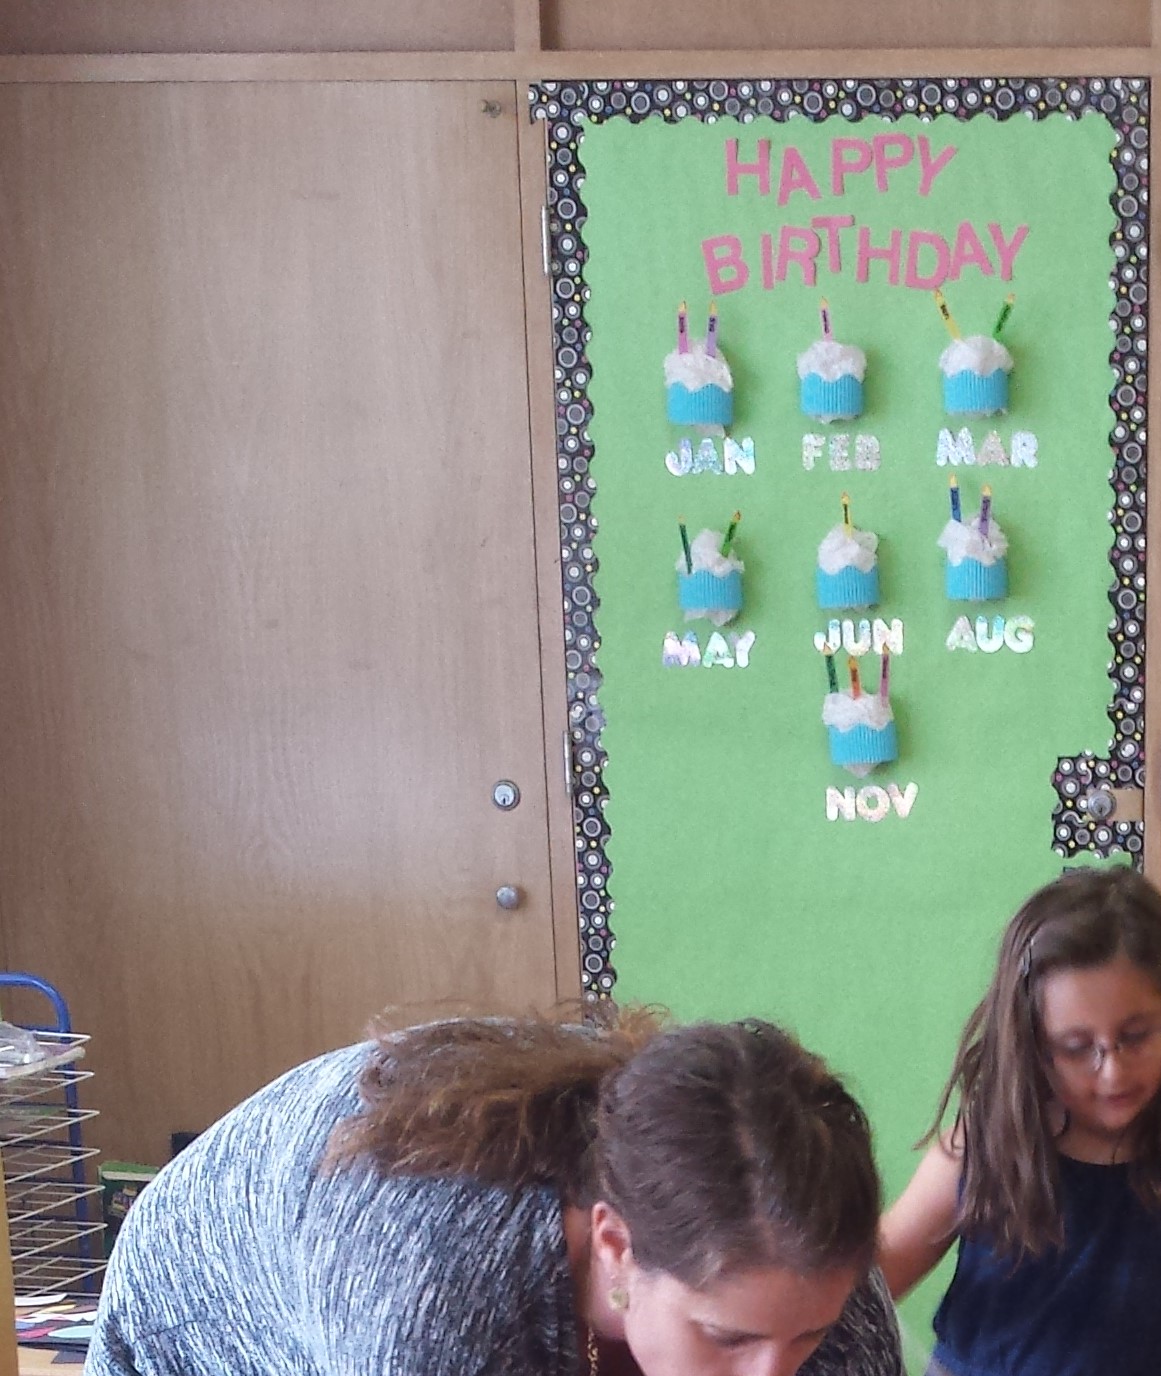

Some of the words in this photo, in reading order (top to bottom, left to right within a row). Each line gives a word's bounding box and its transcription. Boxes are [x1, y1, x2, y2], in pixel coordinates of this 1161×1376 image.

[725, 132, 958, 206] HAPPY
[701, 215, 1029, 296] BIRTHDAY
[665, 437, 756, 477] JAN
[802, 432, 881, 472] FEB
[936, 427, 1039, 469] MAR
[662, 630, 756, 668] MAY
[813, 618, 904, 657] JUN
[945, 615, 1035, 655] AUG
[825, 781, 919, 823] NOV
